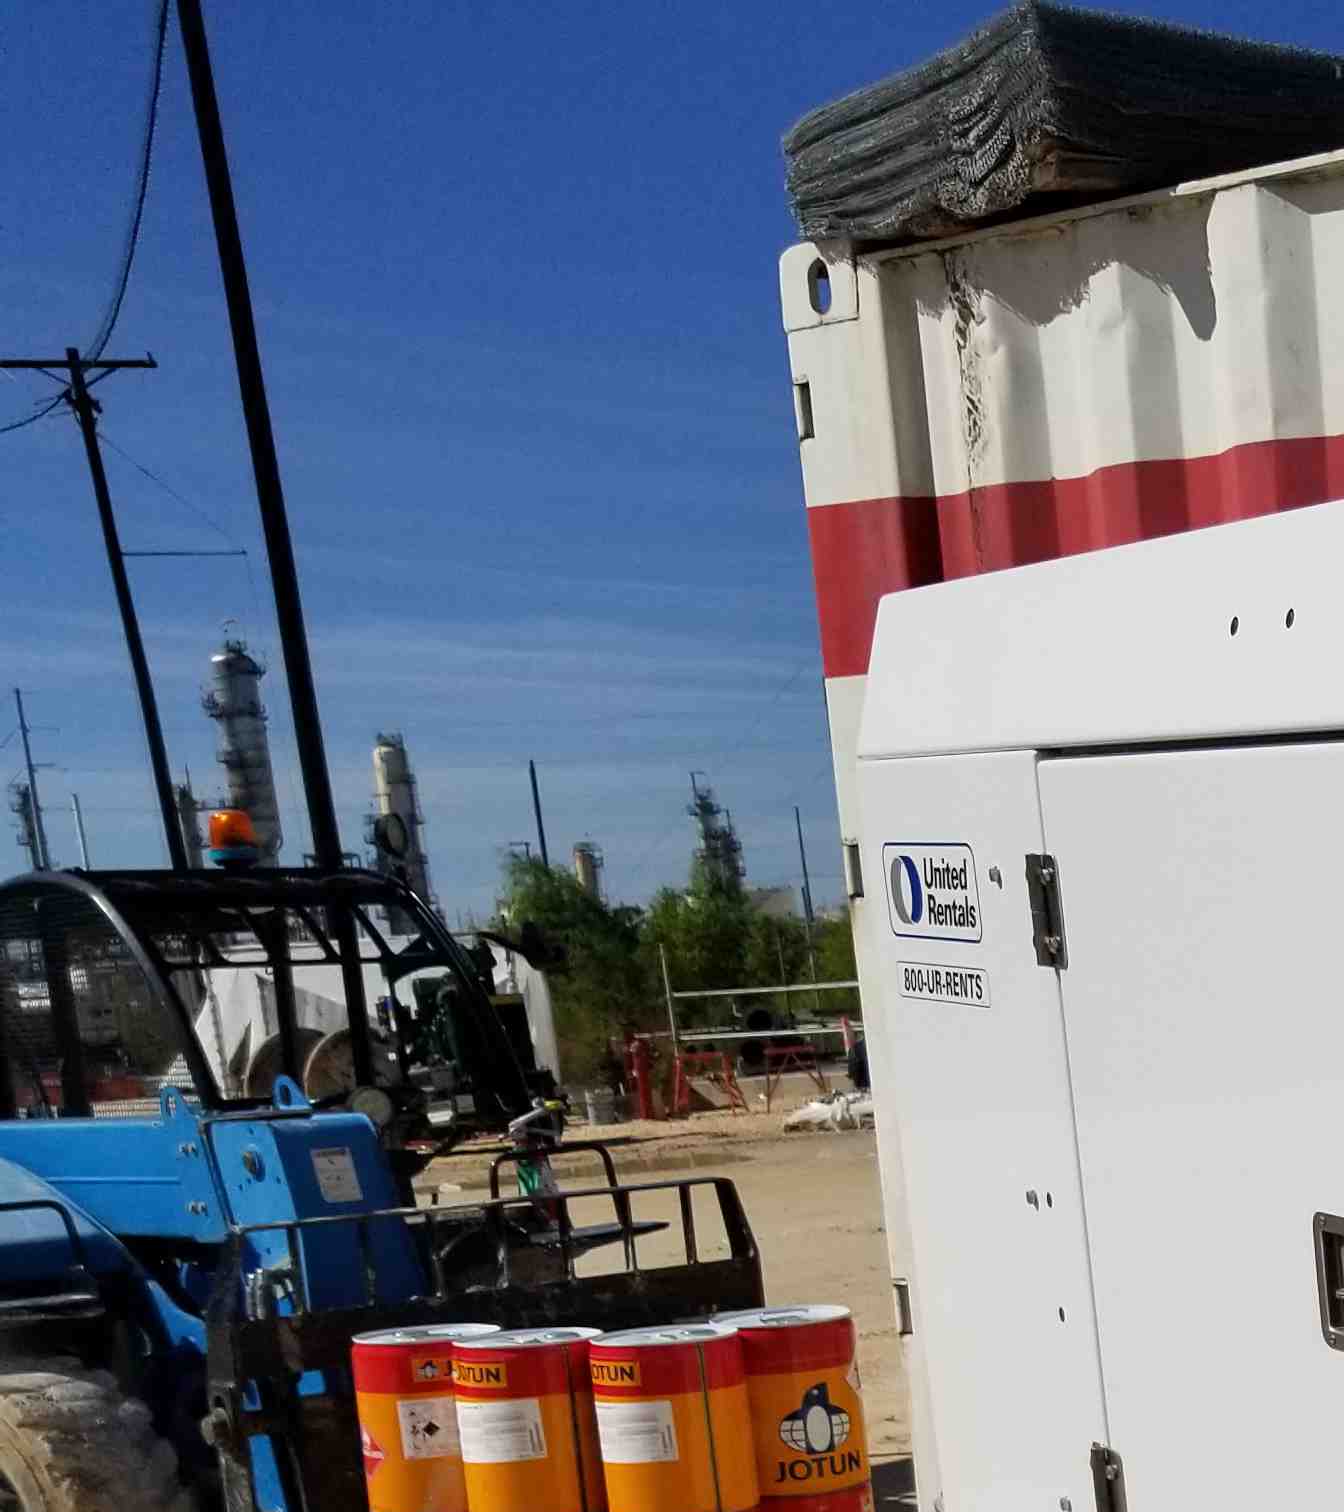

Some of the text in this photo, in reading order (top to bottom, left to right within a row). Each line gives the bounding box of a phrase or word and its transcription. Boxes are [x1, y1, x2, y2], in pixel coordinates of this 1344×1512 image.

[922, 857, 968, 891] United
[927, 894, 977, 929] Rentals
[903, 967, 983, 1001] 800-UR-RENTS
[456, 1365, 501, 1383] OTUN
[592, 1364, 635, 1382] OTUN
[774, 1450, 862, 1483] JOTUN
